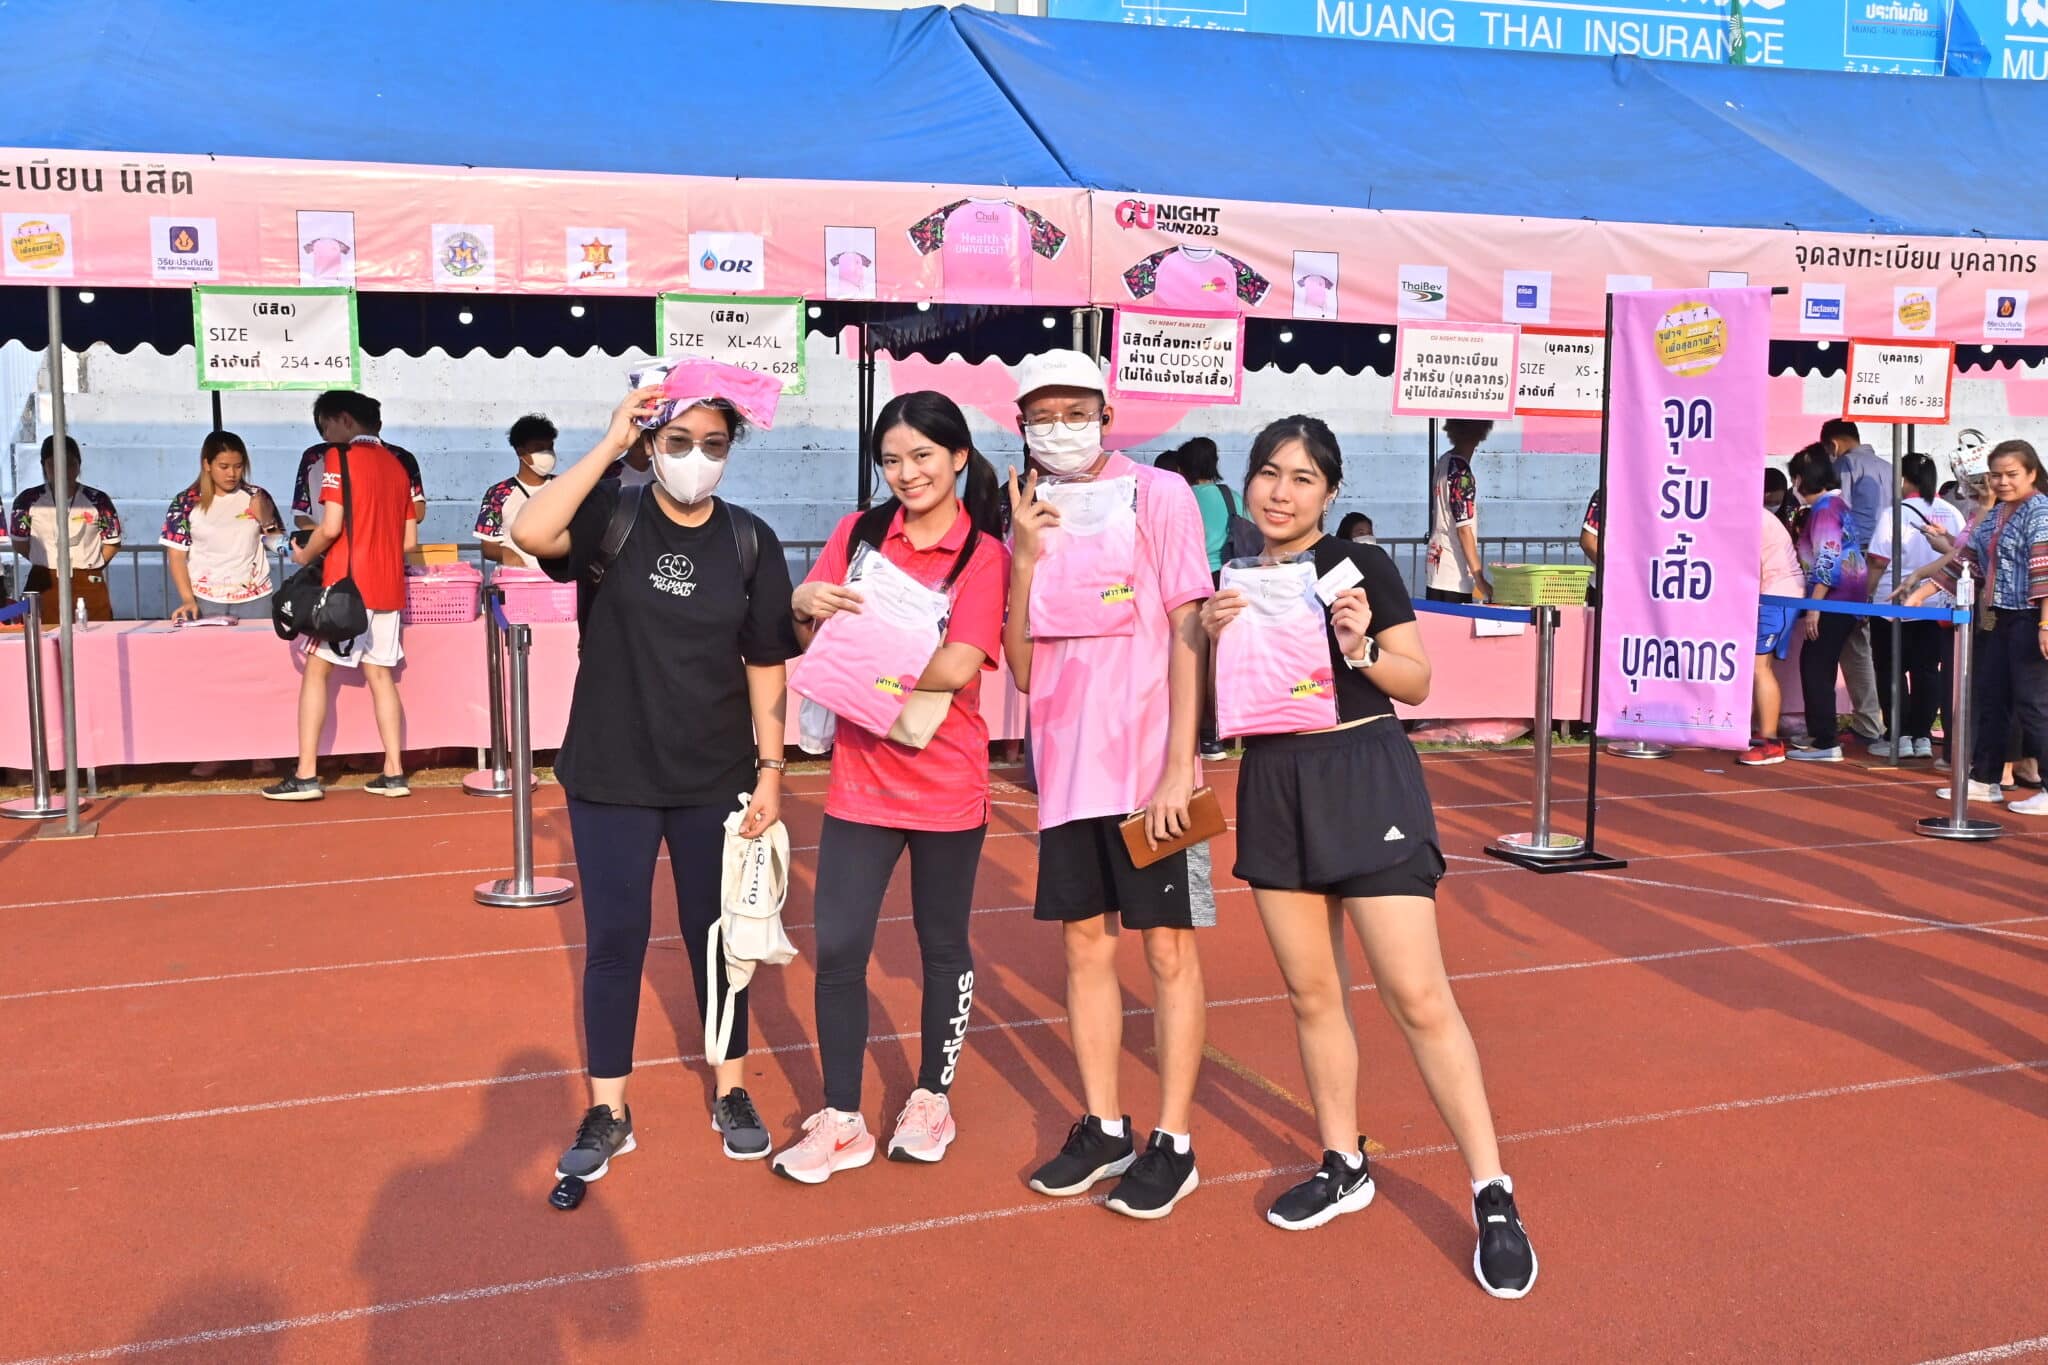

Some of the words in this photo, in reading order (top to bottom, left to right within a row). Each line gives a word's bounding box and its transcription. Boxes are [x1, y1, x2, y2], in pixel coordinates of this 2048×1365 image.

[1316, 0, 1454, 42] MUANG
[1480, 11, 1562, 49] THAI
[1584, 19, 1784, 64] INSURANCE
[120, 163, 193, 194] นิสิต
[1156, 204, 1220, 223] NIGHT
[961, 231, 999, 245] Health
[955, 243, 1010, 256] UNIVERSIT
[719, 259, 753, 273] OR
[1795, 244, 1940, 272] จุดลงทะเบียน
[1950, 252, 2037, 278] บุคลากร
[1401, 280, 1442, 291] ThaiBev
[210, 328, 249, 342] SIZE
[285, 329, 294, 342] L
[669, 333, 704, 347] SIZE
[727, 335, 782, 349] XL-4XL
[1545, 341, 1594, 355] (บุคลากร)
[281, 356, 309, 368] 254
[324, 356, 352, 368] 461
[1130, 349, 1155, 364] ผ่าน
[1160, 353, 1224, 368] CUDSON
[1416, 352, 1498, 367] จุดลงทะเบียน
[1879, 352, 1923, 365] (บุคลากร)
[772, 362, 799, 374] 628
[1520, 363, 1545, 374] SIZE
[1575, 365, 1590, 377] XS
[1402, 368, 1445, 383] สำหรับ
[1450, 370, 1509, 388] (บุคลากร)
[1856, 372, 1881, 383] SIZE
[1914, 375, 1924, 385] M
[1518, 382, 1555, 397] ลำดับที่
[1853, 391, 1889, 405] ลำดับที่
[1900, 396, 1917, 406] 186
[1926, 396, 1944, 407] 383
[1664, 399, 1712, 455] จุด
[1660, 466, 1709, 520] รับ
[1651, 533, 1712, 600] เสื้อ
[649, 573, 668, 585] NOT
[668, 580, 697, 592] HAPPY
[653, 581, 672, 592] NOT
[1622, 637, 1736, 692] บุคลากร
[940, 970, 974, 1086] adidas
